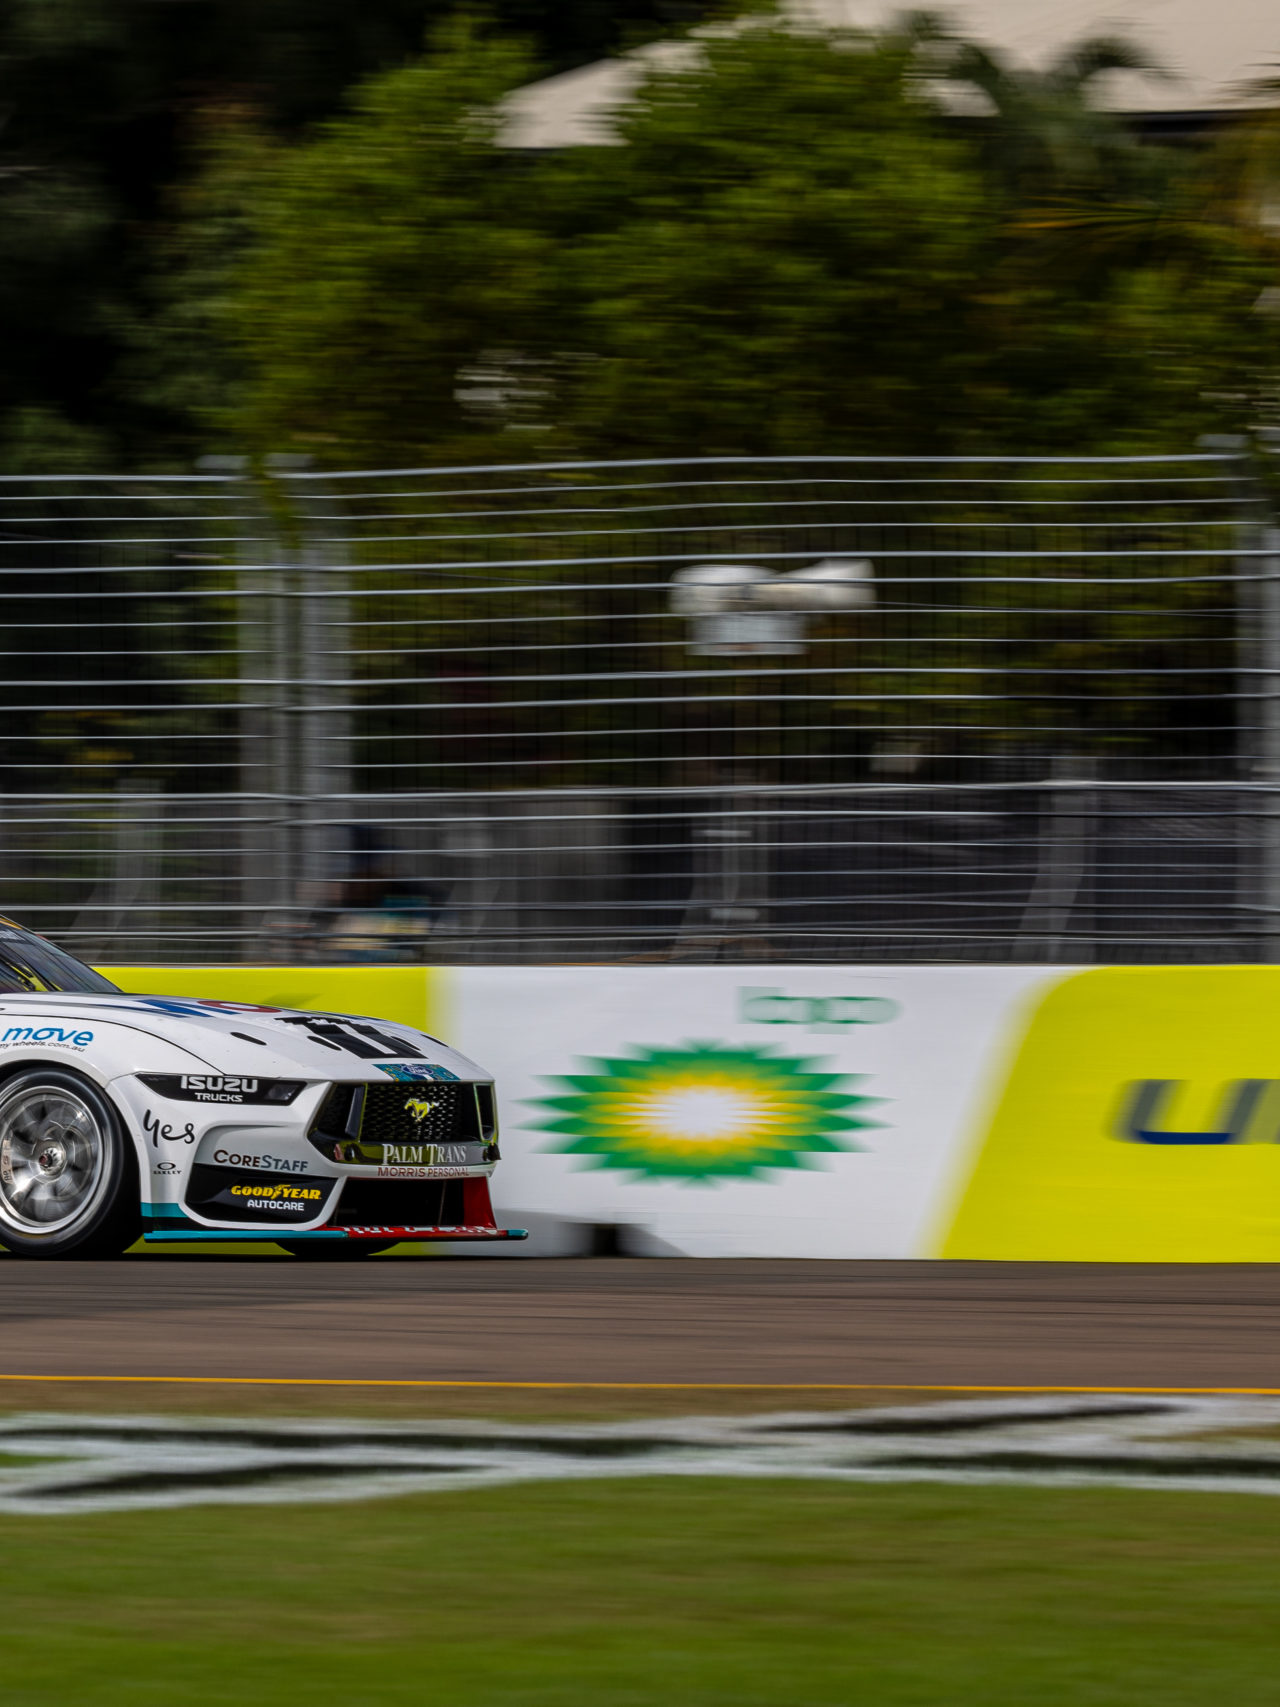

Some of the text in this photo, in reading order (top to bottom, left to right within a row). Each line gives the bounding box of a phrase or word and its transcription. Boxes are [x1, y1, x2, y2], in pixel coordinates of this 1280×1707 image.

[1, 1026, 94, 1047] move
[180, 1075, 258, 1093] ISUZU
[194, 1092, 243, 1103] TRUCKS
[142, 1109, 196, 1148] yes
[381, 1143, 467, 1166] PALM TRANS
[378, 1167, 470, 1177] MORRIS PERSONAL
[231, 1184, 322, 1200] GOODYEAR
[247, 1199, 305, 1211] AUTOCARE
